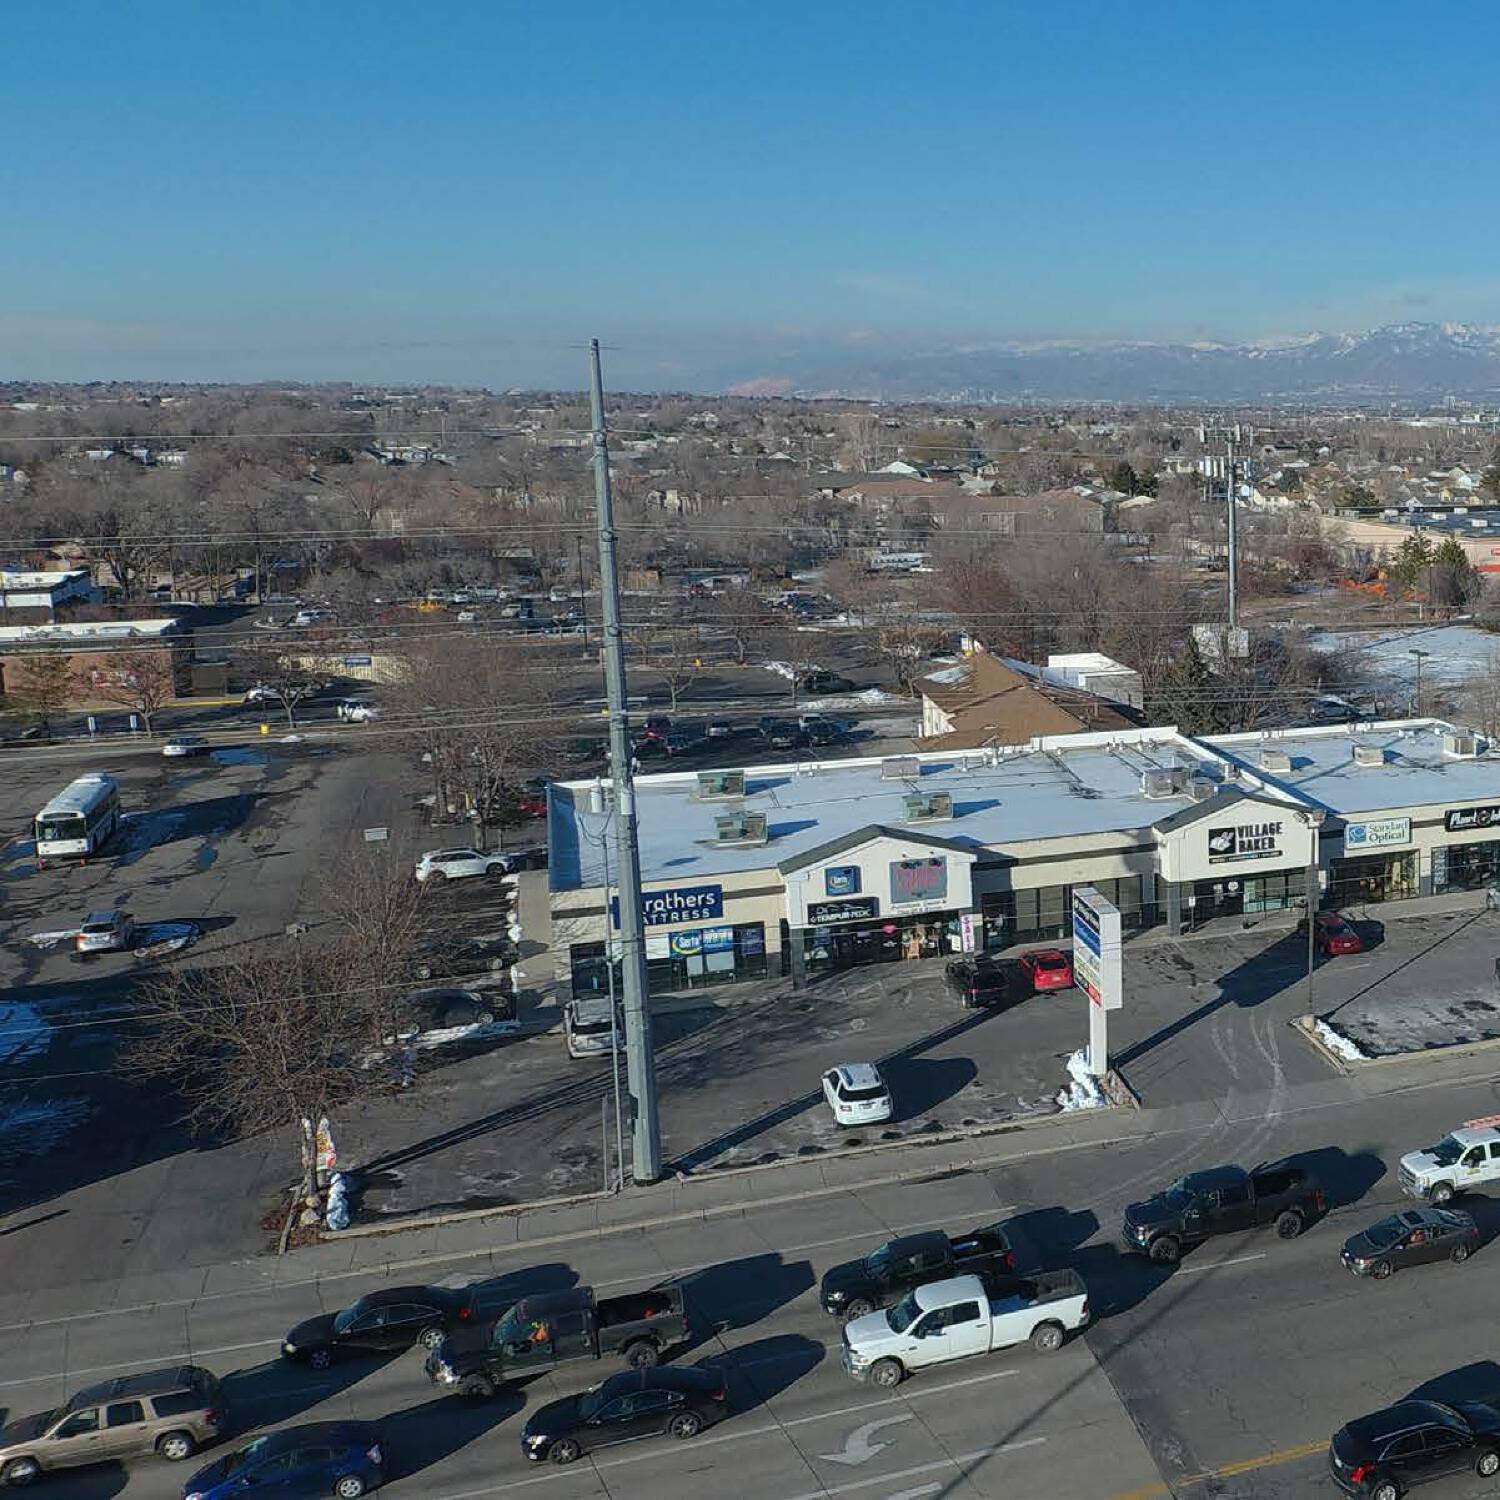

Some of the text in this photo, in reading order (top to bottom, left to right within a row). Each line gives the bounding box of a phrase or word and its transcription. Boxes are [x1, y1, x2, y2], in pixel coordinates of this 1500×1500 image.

[1238, 821, 1283, 839] VILLAGE
[1369, 818, 1408, 832] Standard
[1238, 836, 1275, 853] BAKER
[1368, 831, 1405, 844] Optical
[643, 891, 716, 914] rothers
[641, 907, 711, 925] ATTRESS
